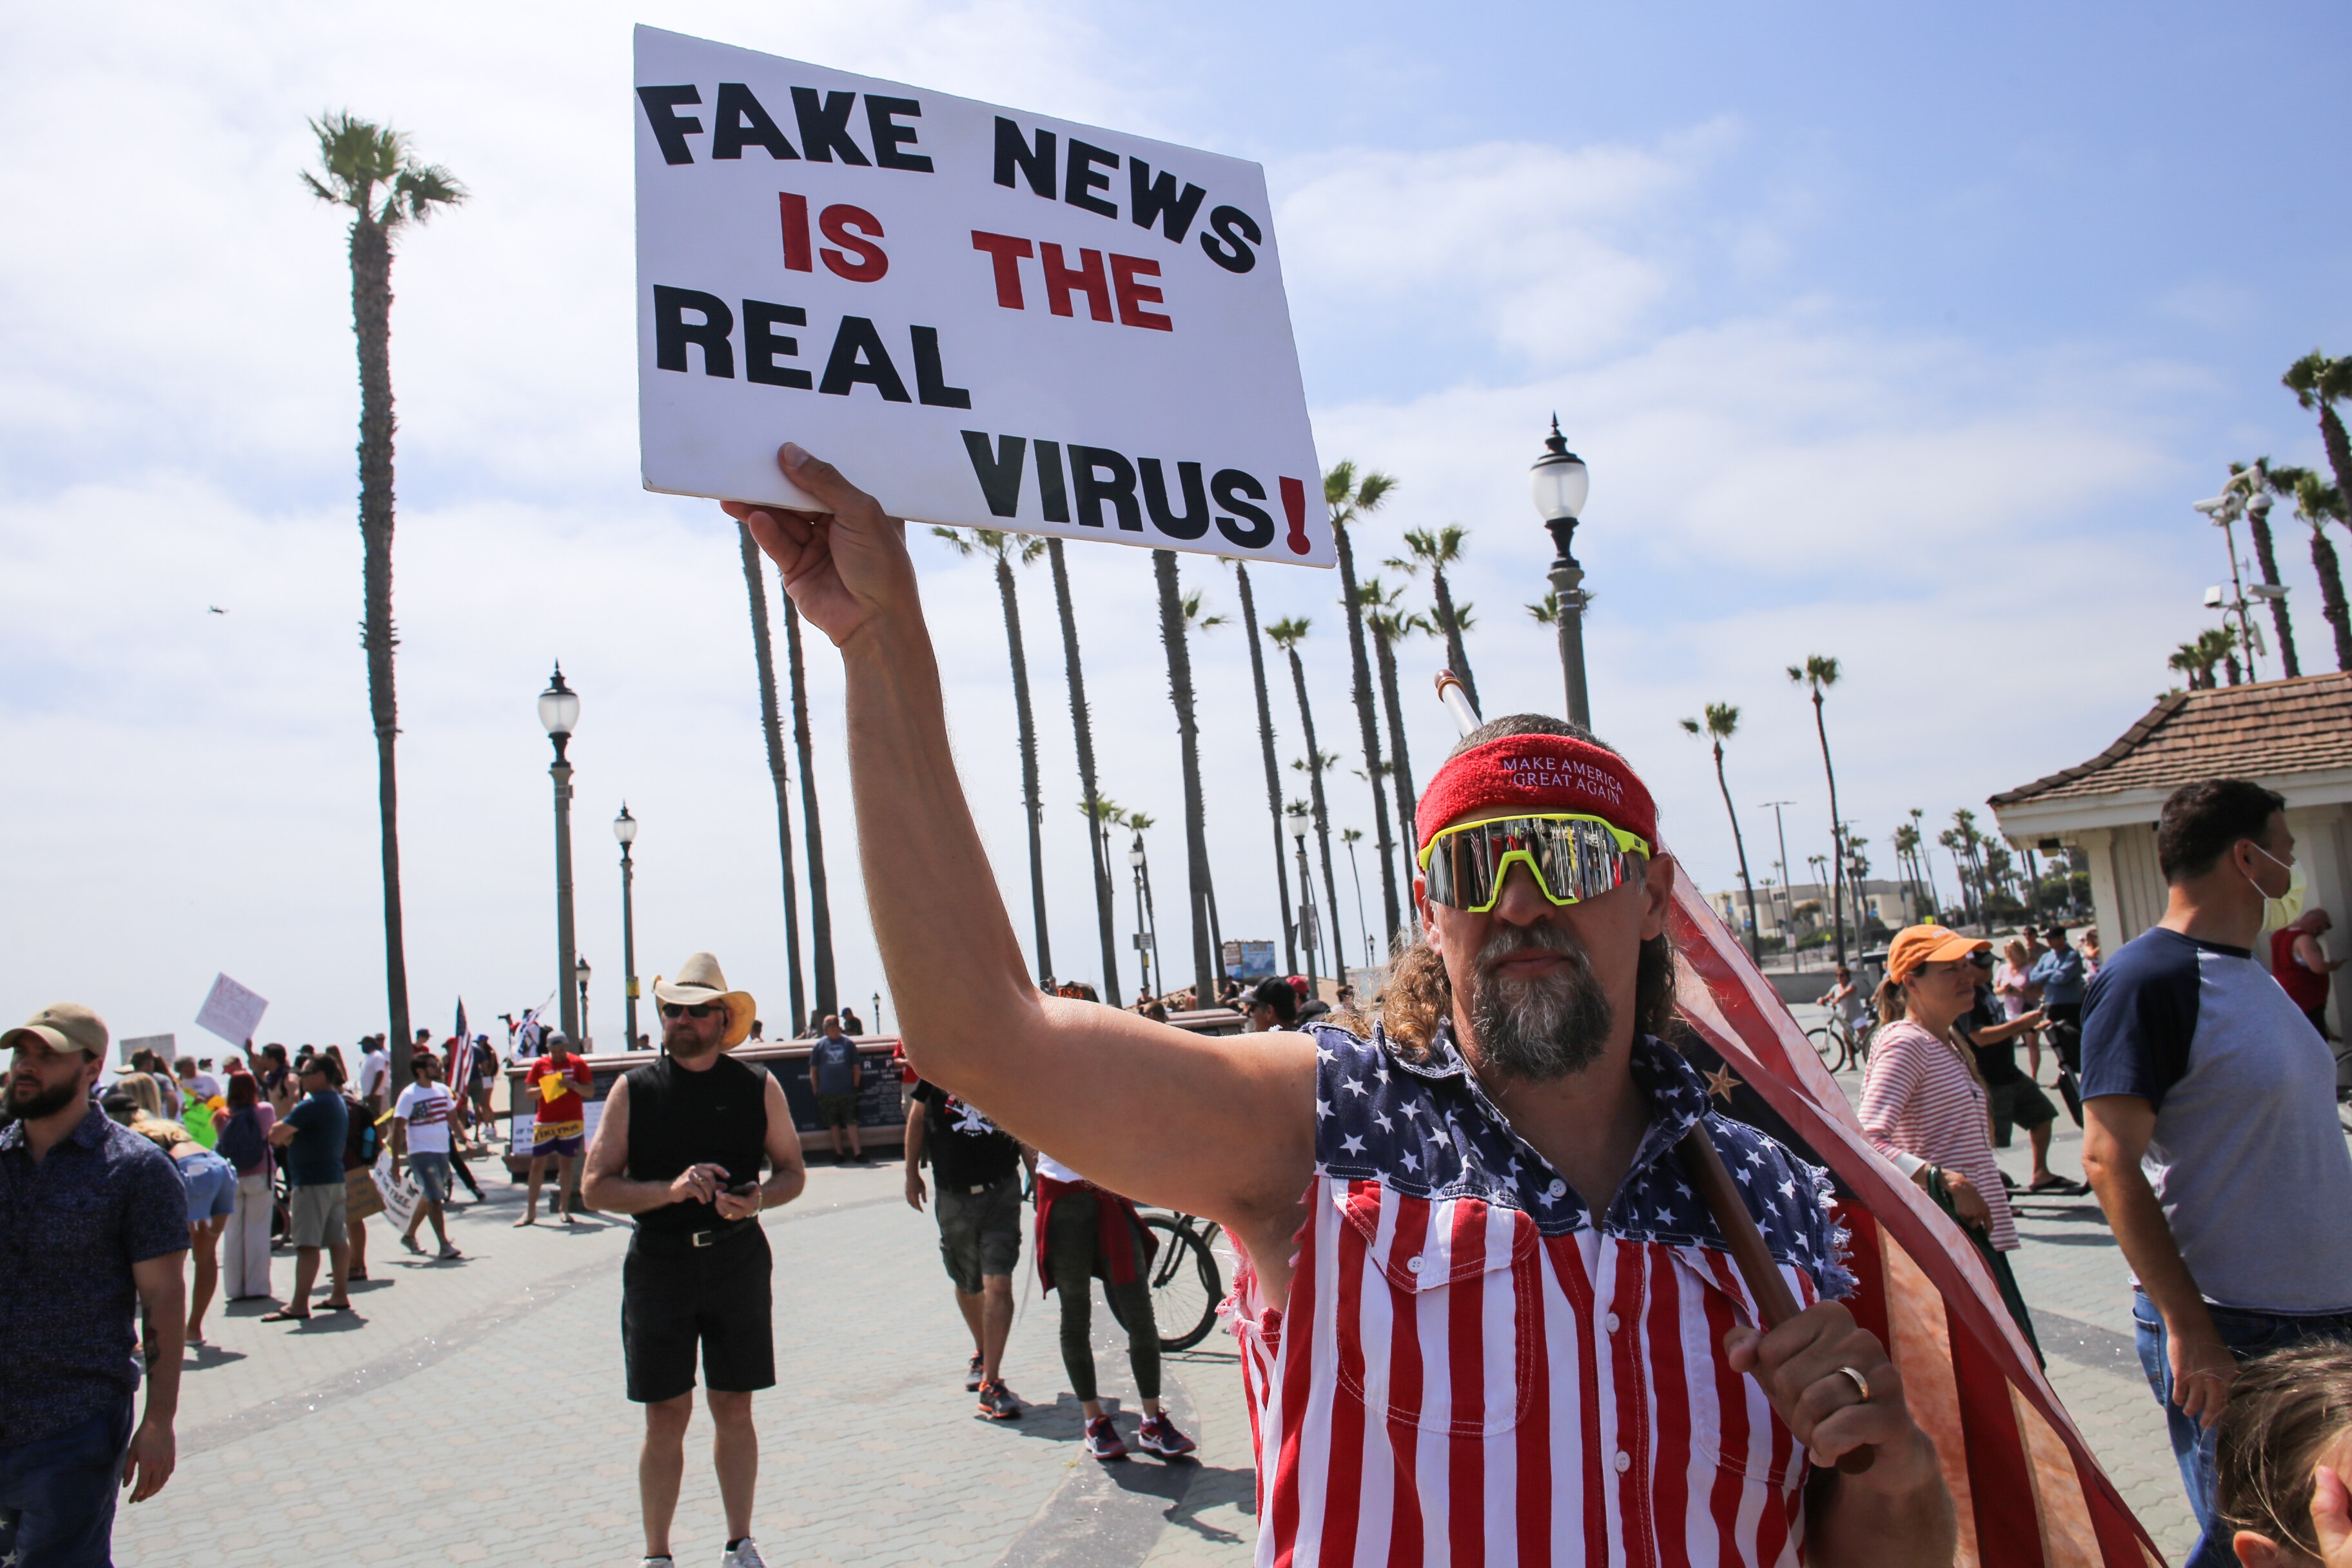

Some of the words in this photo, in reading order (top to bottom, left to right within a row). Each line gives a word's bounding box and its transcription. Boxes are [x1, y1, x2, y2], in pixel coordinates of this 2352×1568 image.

[636, 83, 935, 173] FAKE
[994, 115, 1262, 274] NEWS
[781, 192, 888, 282] IS
[972, 230, 1173, 332] THE
[653, 284, 972, 410] REAL
[960, 430, 1311, 555] VIRUS!
[1503, 757, 1556, 771] MAKE
[1561, 759, 1623, 795] AMERICA
[1513, 772, 1572, 787] GREAT
[1576, 778, 1620, 805] AGAIN
